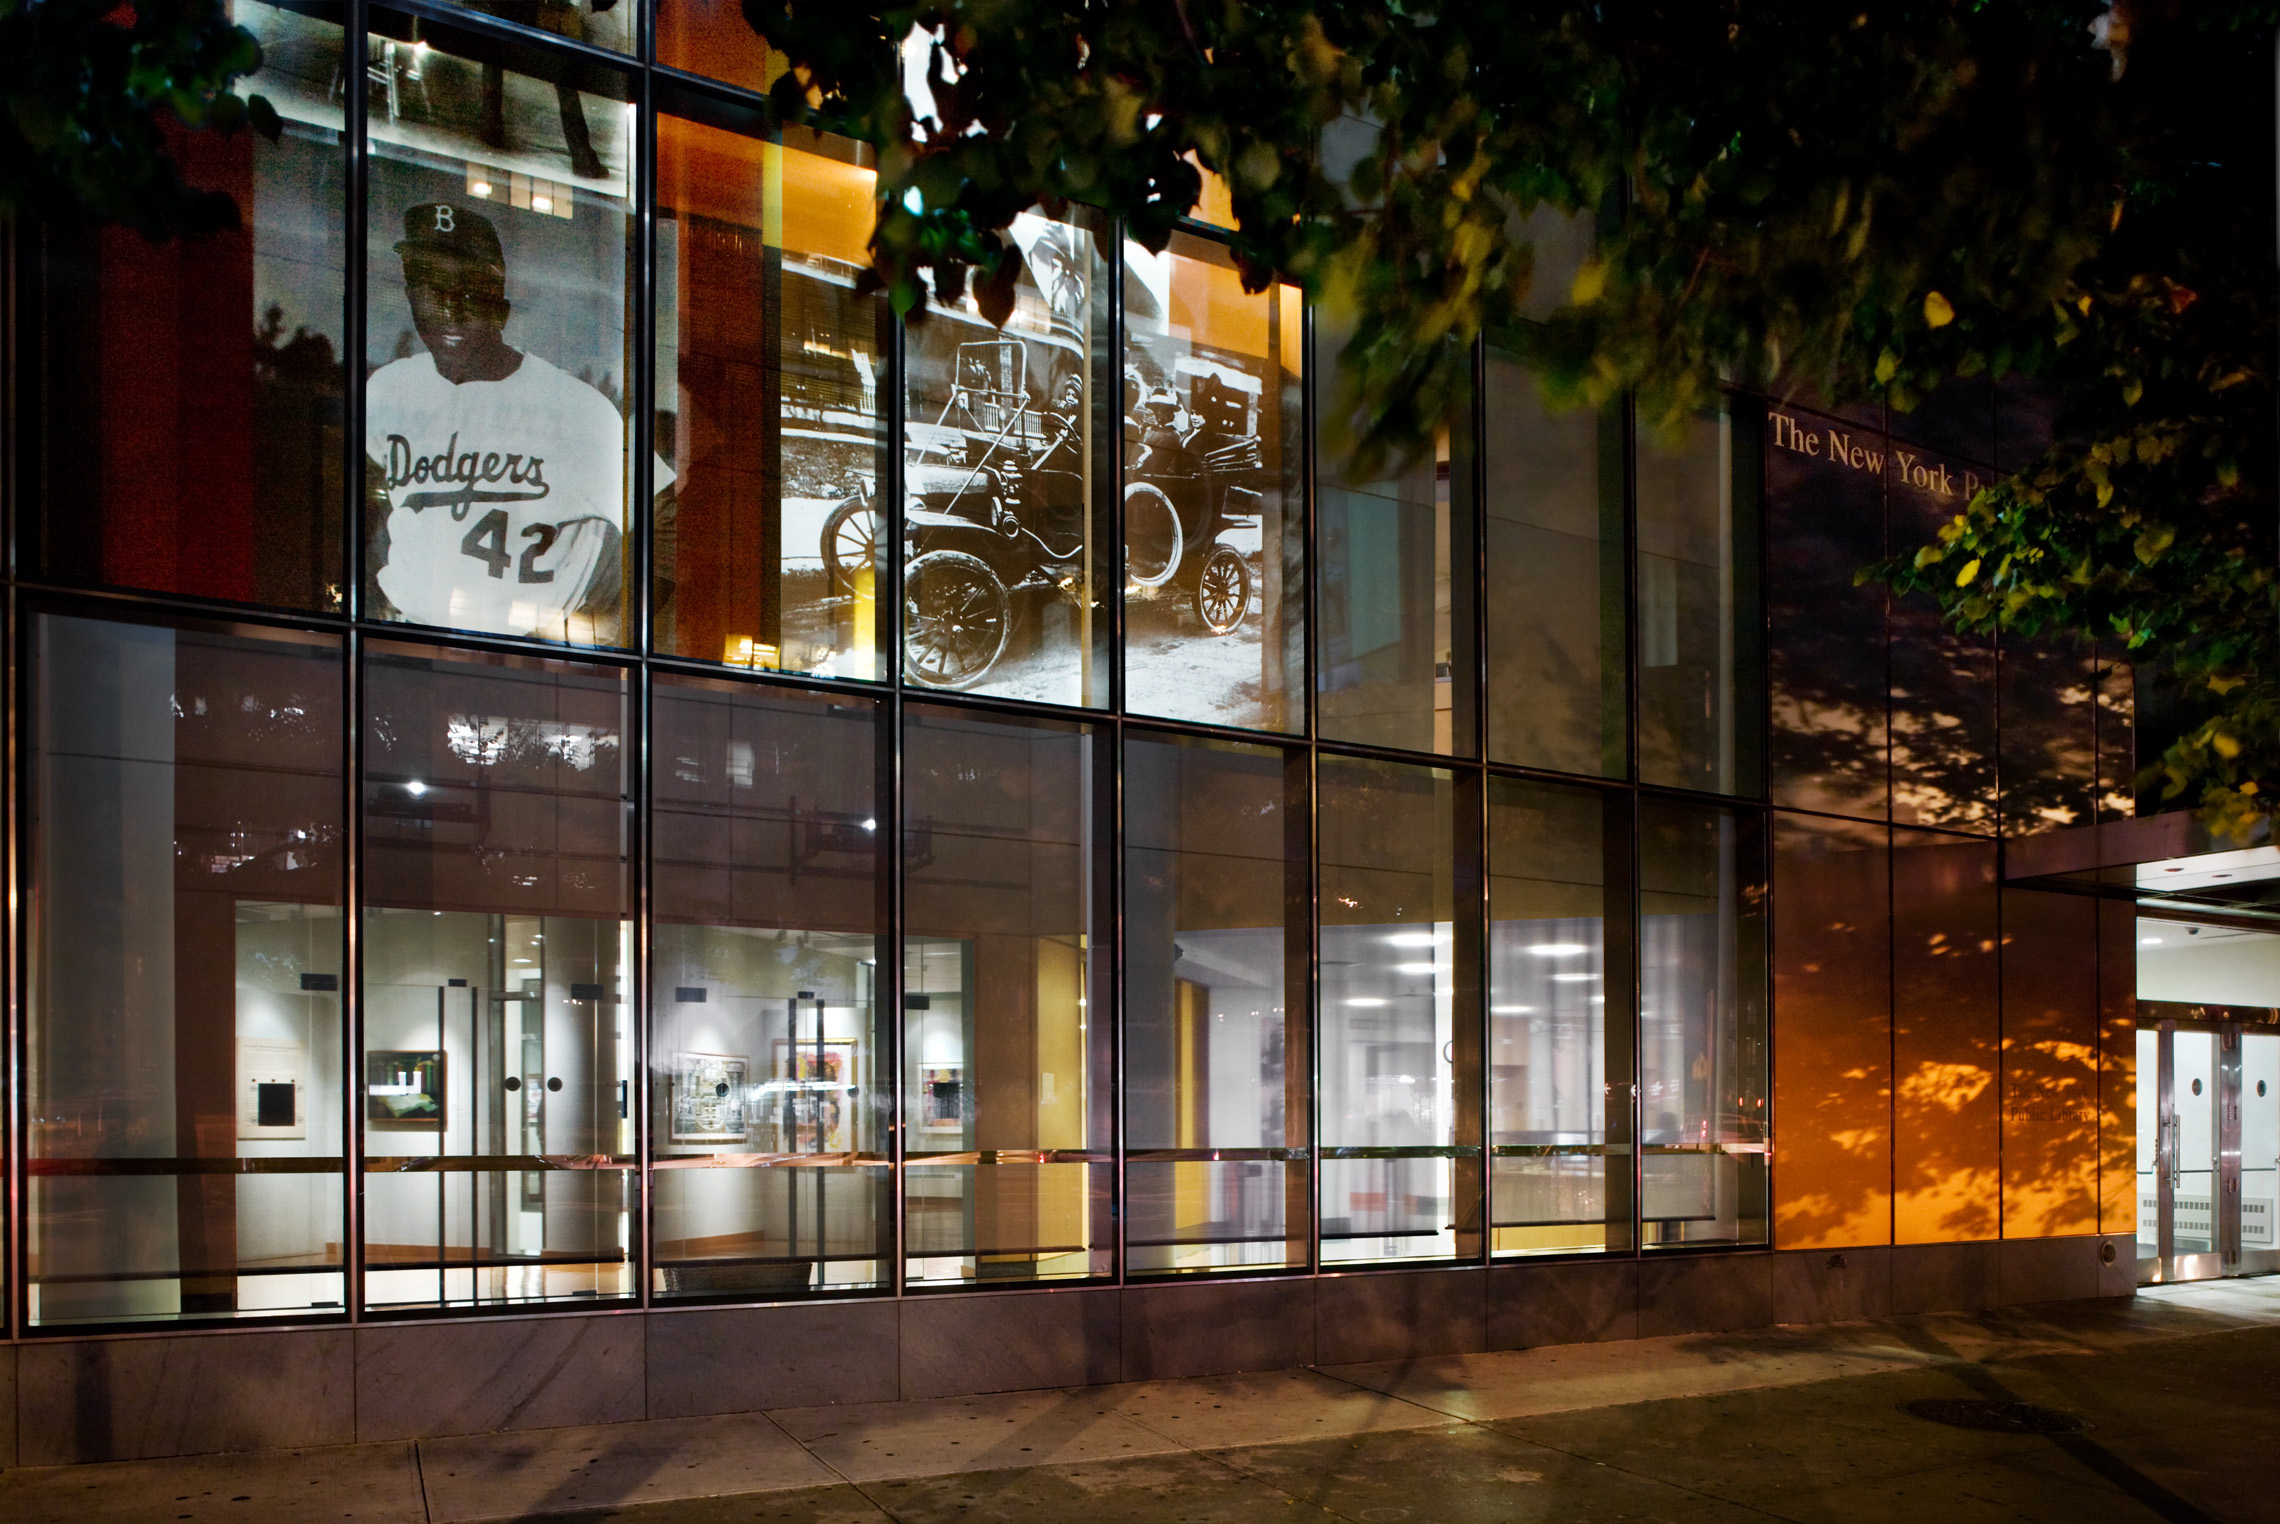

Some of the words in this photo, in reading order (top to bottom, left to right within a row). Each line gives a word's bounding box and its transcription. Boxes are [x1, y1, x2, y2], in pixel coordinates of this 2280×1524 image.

[434, 205, 456, 232] B
[387, 431, 550, 522] Dodgers
[1768, 412, 1820, 456] The
[1828, 430, 1885, 475] New
[1896, 450, 1954, 497] York
[461, 509, 557, 584] 42
[2011, 1106, 2047, 1122] Public
[2050, 1106, 2090, 1126] Library
